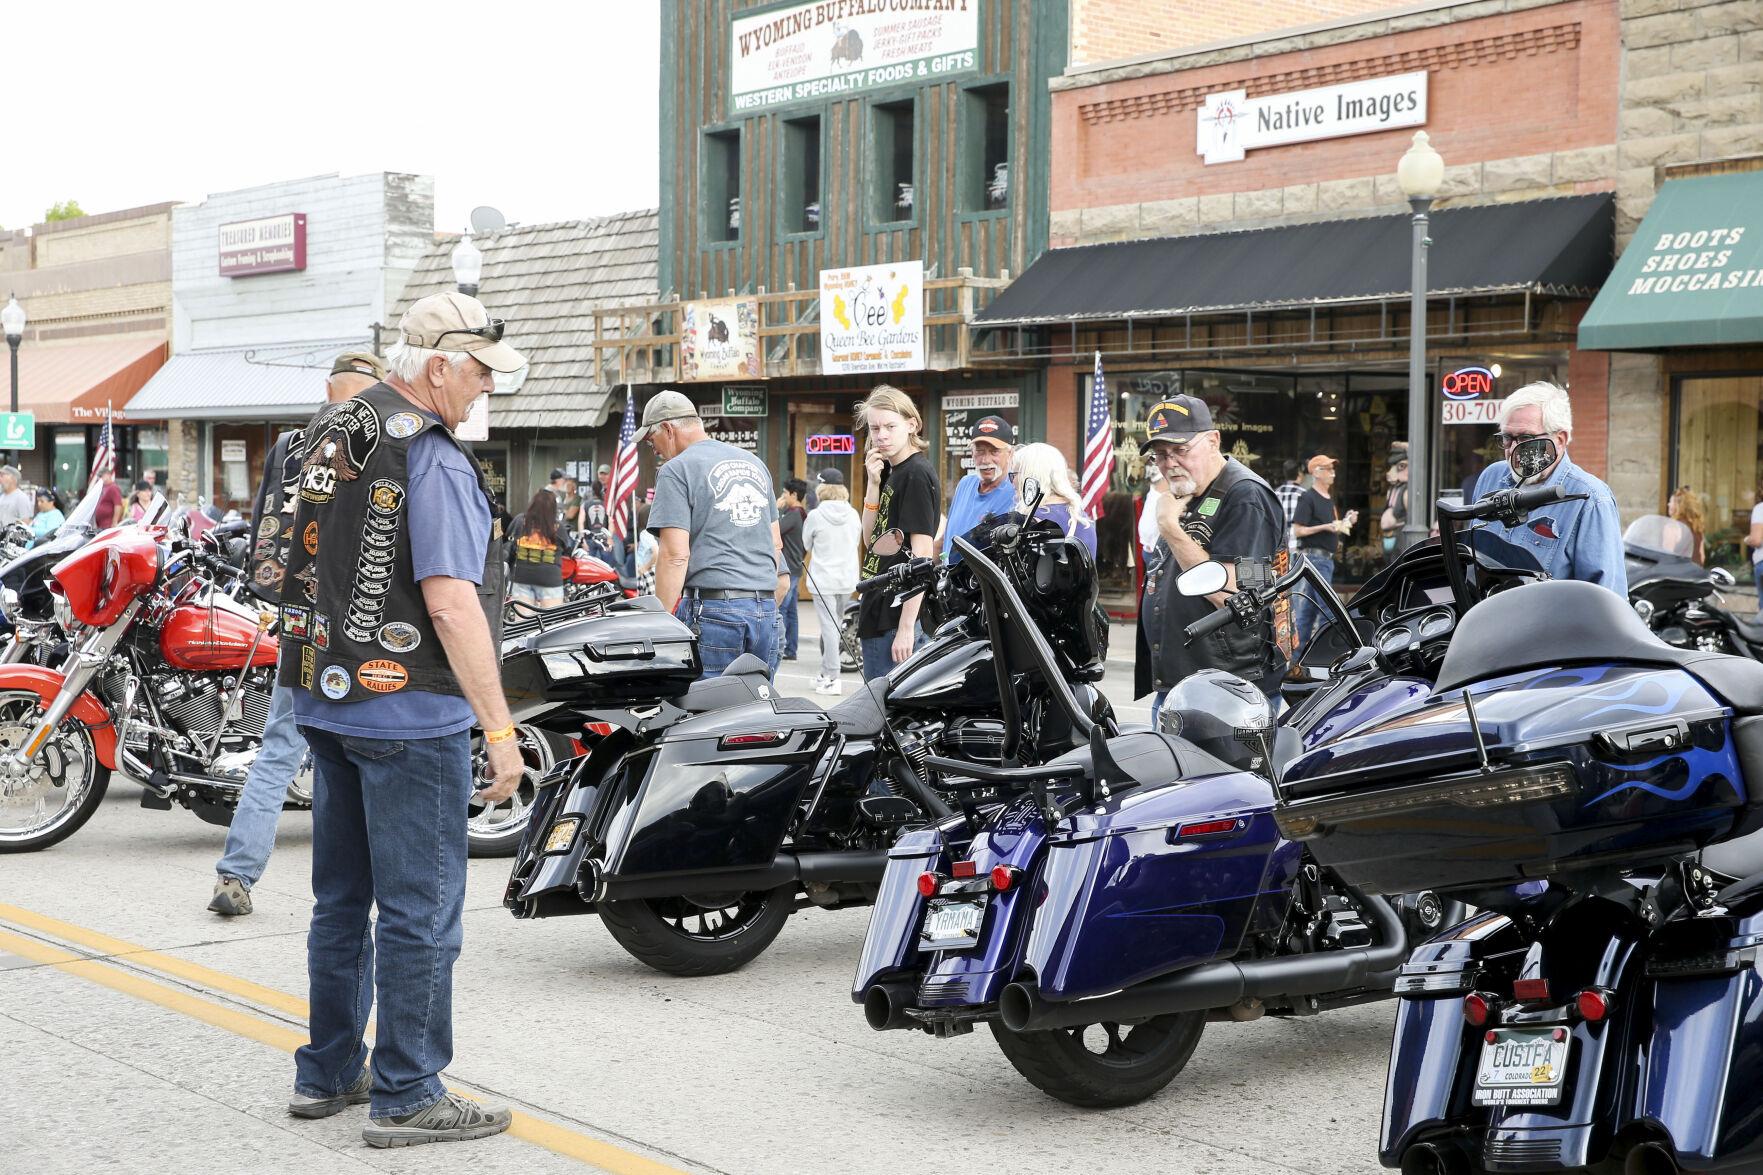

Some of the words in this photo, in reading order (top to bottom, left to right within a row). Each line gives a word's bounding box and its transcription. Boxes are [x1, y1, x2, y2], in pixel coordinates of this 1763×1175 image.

[739, 8, 812, 58] WYOMING
[815, 0, 887, 26] BUFFALO
[735, 85, 793, 109] WESTERN
[795, 72, 865, 98] SPECIALTY
[868, 63, 913, 85] FOODS
[917, 60, 928, 76] &
[932, 52, 973, 72] GIFTS
[1258, 100, 1325, 132] Native
[1337, 90, 1418, 121] Images
[222, 227, 256, 247] TREASURED
[259, 222, 291, 241] MEMORIES
[1654, 227, 1745, 251] BOOTS
[1641, 250, 1732, 273] SHOES
[825, 333, 855, 352] Queen
[856, 330, 875, 347] Bee
[878, 328, 919, 347] Gardens
[1443, 373, 1491, 393] OPEN
[728, 388, 764, 399] Wyoming
[731, 396, 760, 405] Buffalo
[946, 397, 975, 407] WYOMING
[977, 395, 1006, 407] BUFFALO
[72, 406, 92, 417] The
[726, 404, 763, 414] Company
[1443, 402, 1502, 421] 30-70
[328, 413, 361, 434] CHAPTER
[355, 406, 376, 442] NEVADA
[1242, 422, 1273, 433] Images
[809, 437, 853, 452] OPEN
[368, 661, 399, 671] STATE
[366, 680, 396, 691] RALLIES
[1493, 1043, 1553, 1068] CUSIFA
[1534, 1066, 1546, 1077] 22
[1475, 1089, 1492, 1100] IRON
[1493, 1089, 1511, 1099] BUTT
[1511, 1088, 1558, 1099] ASSOCIATION
